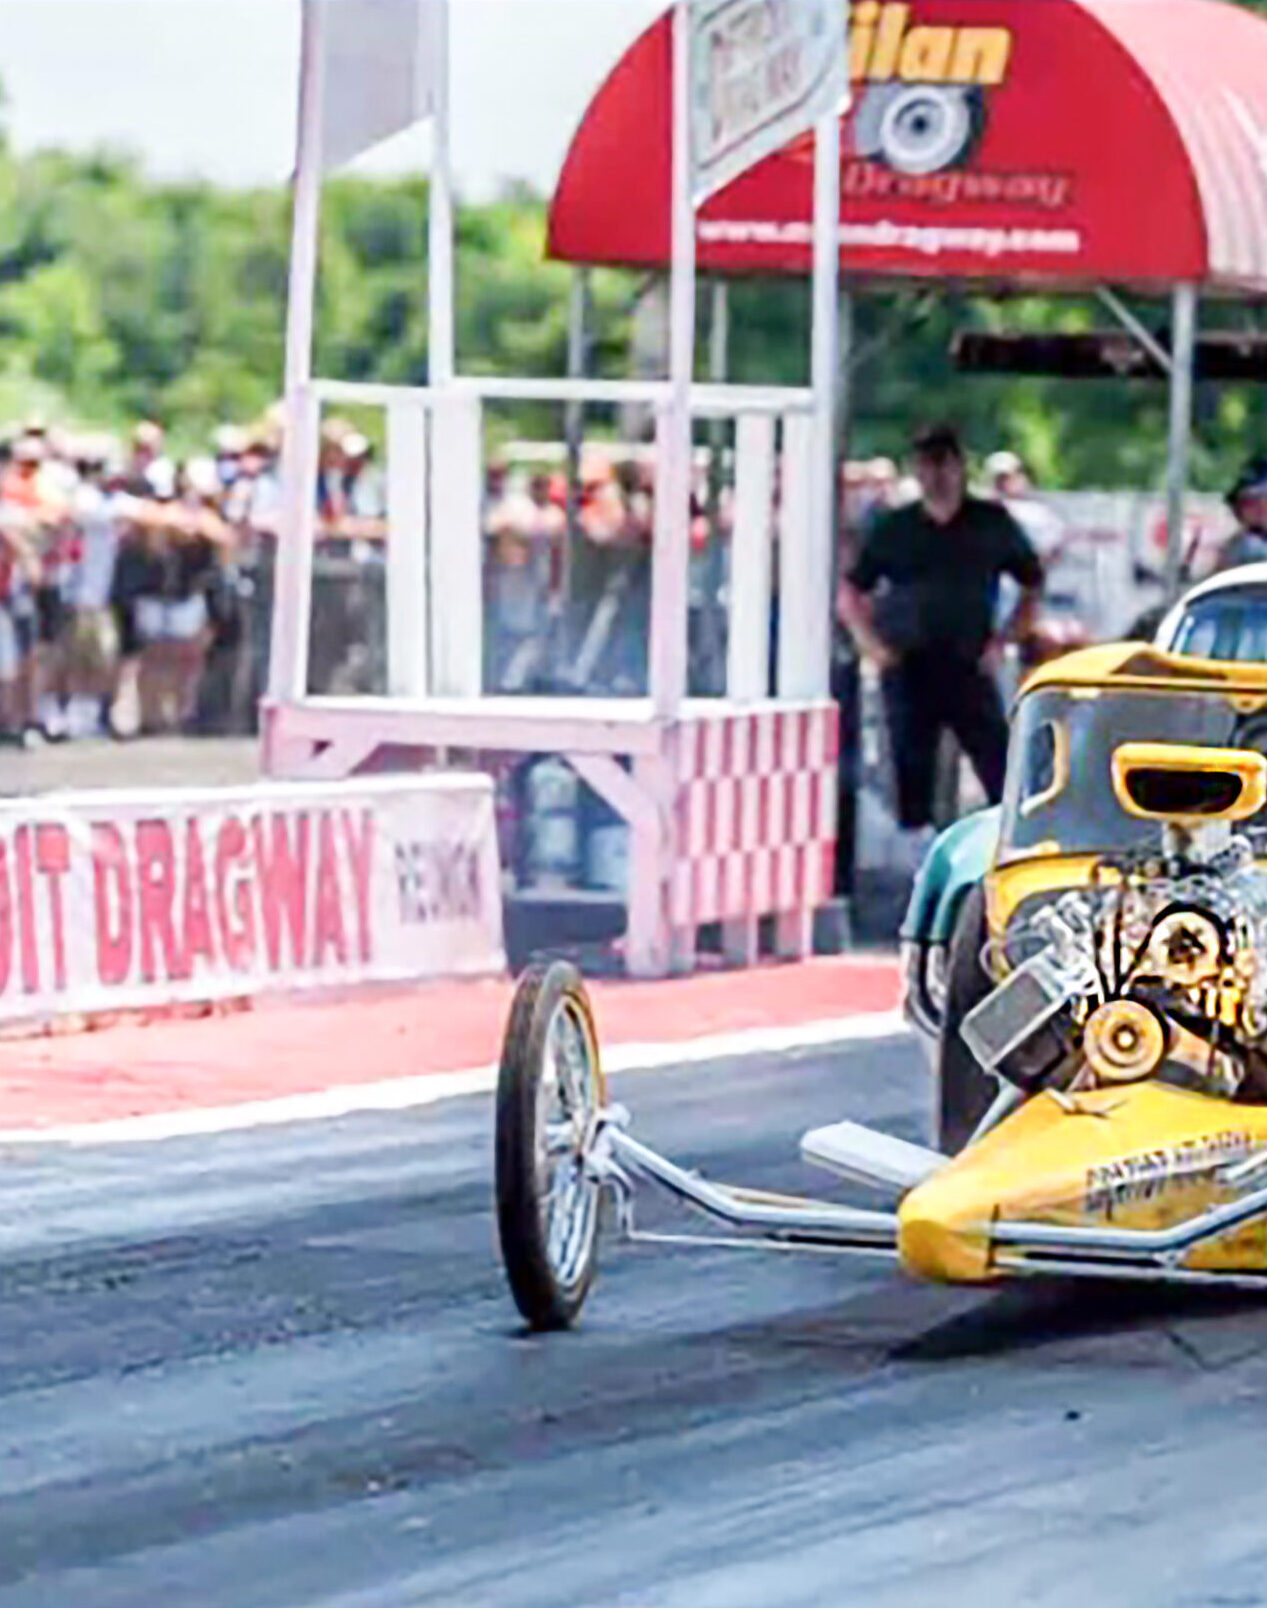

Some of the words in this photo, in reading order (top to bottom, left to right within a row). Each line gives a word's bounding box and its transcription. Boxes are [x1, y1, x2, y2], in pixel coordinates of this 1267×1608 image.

[850, 0, 1011, 84] ilan
[844, 165, 1069, 206] Dragway
[92, 809, 372, 984] DRAGWAY
